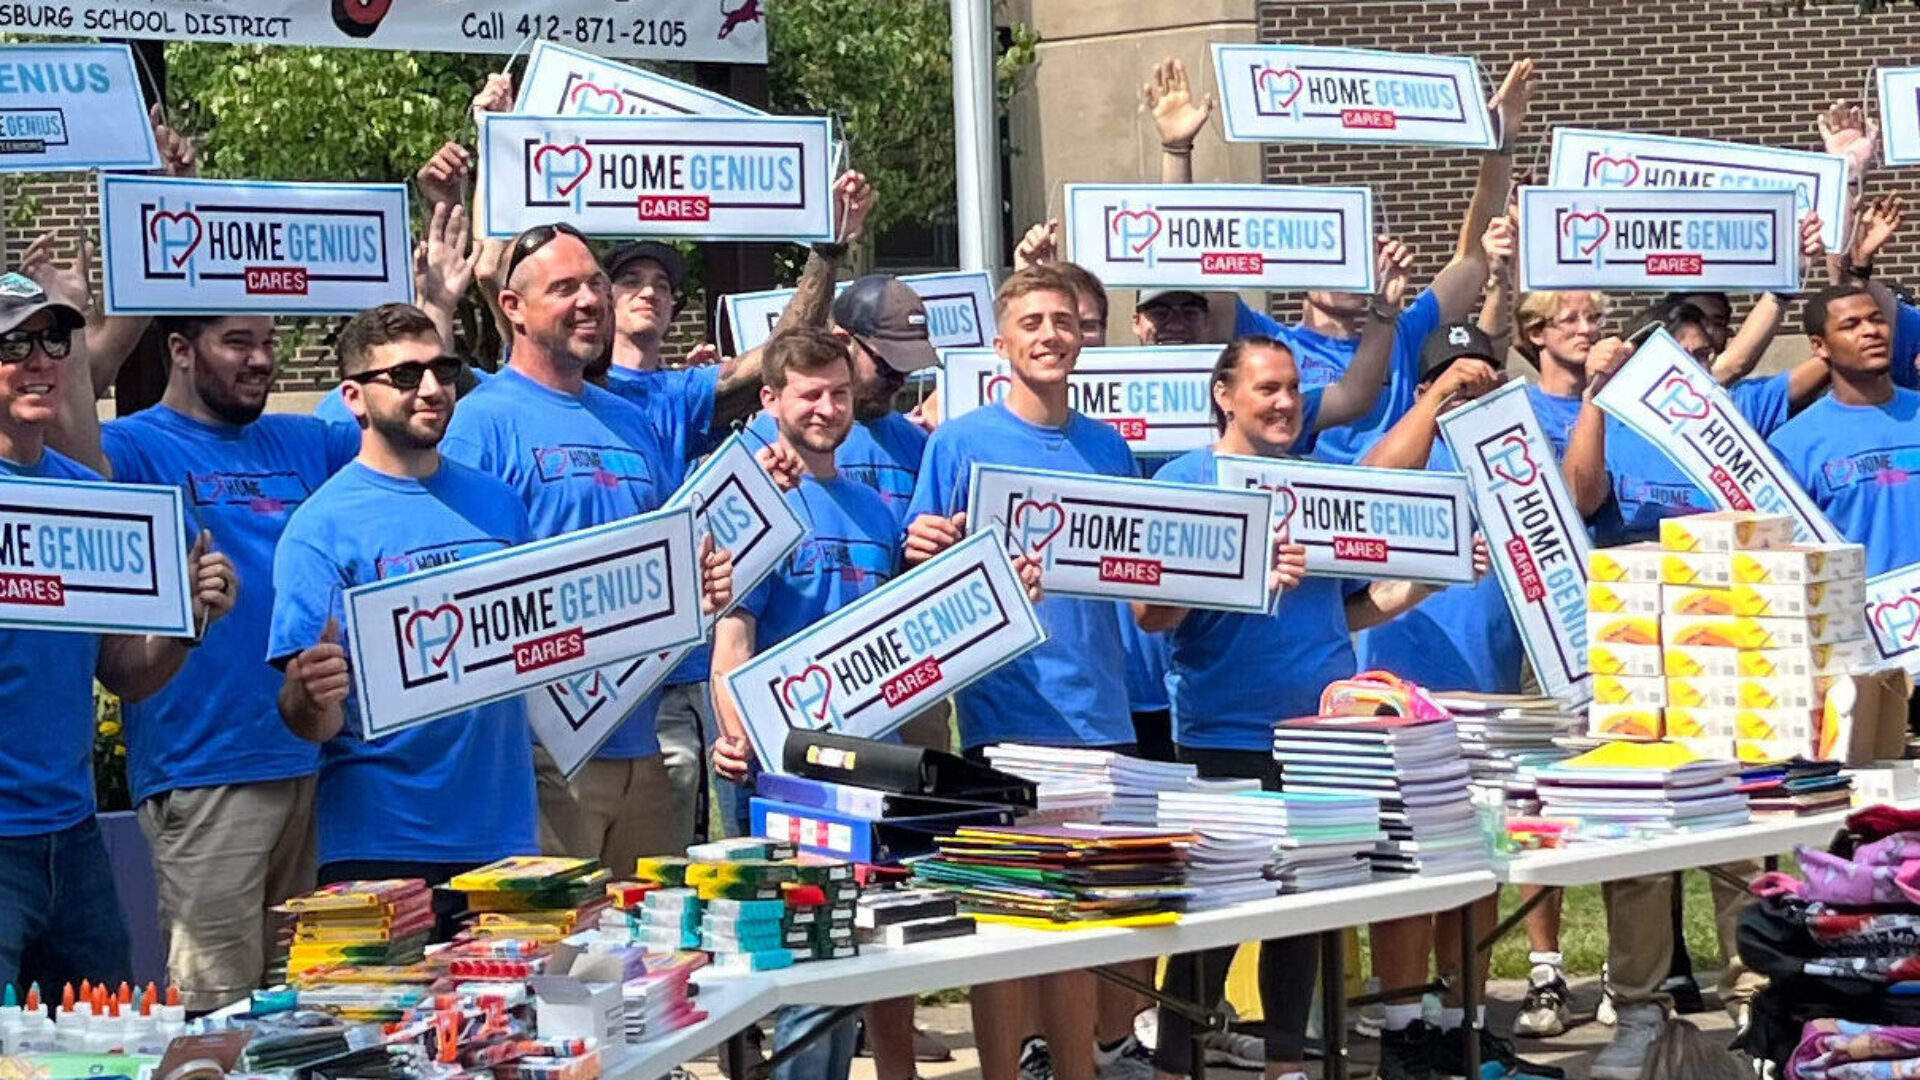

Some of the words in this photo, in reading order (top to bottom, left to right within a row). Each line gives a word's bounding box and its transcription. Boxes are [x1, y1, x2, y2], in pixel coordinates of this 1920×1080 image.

[84, 9, 176, 33] SCHOOL
[186, 13, 291, 38] DISTRICT
[462, 12, 504, 39] Call
[515, 14, 687, 47] 412-871-2105
[1307, 77, 1373, 105] HOME
[1375, 79, 1455, 110] GENIUS
[6, 115, 61, 137] GENIUS
[1343, 111, 1394, 126] CARES
[600, 154, 684, 190] HOME
[690, 155, 795, 192] GENIUS
[640, 199, 708, 217] CARES
[208, 221, 284, 261] HOME
[288, 223, 377, 264] GENIUS
[1168, 217, 1241, 248] HOME
[1245, 218, 1336, 251] GENIUS
[1615, 219, 1683, 250] HOME
[1687, 219, 1769, 251] GENIUS
[248, 271, 305, 291] CARES
[1203, 256, 1260, 272] CARES
[1648, 257, 1700, 272] CARES
[929, 304, 974, 337] NIUS
[1068, 382, 1122, 413] OME
[1128, 380, 1207, 413] GENIU
[1700, 419, 1764, 493] HOME
[1302, 496, 1367, 533] HOME
[1370, 501, 1449, 539] GENIUS
[1513, 489, 1567, 572] HOME
[38, 525, 145, 574] GENIUS
[1069, 512, 1144, 553] HOME
[1147, 519, 1237, 562] GENIUS
[1335, 540, 1385, 559] CARES
[1101, 560, 1158, 582] CARES
[1508, 541, 1542, 600] CARES
[470, 586, 557, 647] HOME
[560, 558, 662, 623] GENIUS
[516, 633, 582, 667] CARES
[832, 627, 911, 696] HOME
[903, 580, 993, 654] GENIUS
[884, 663, 939, 703] CARES
